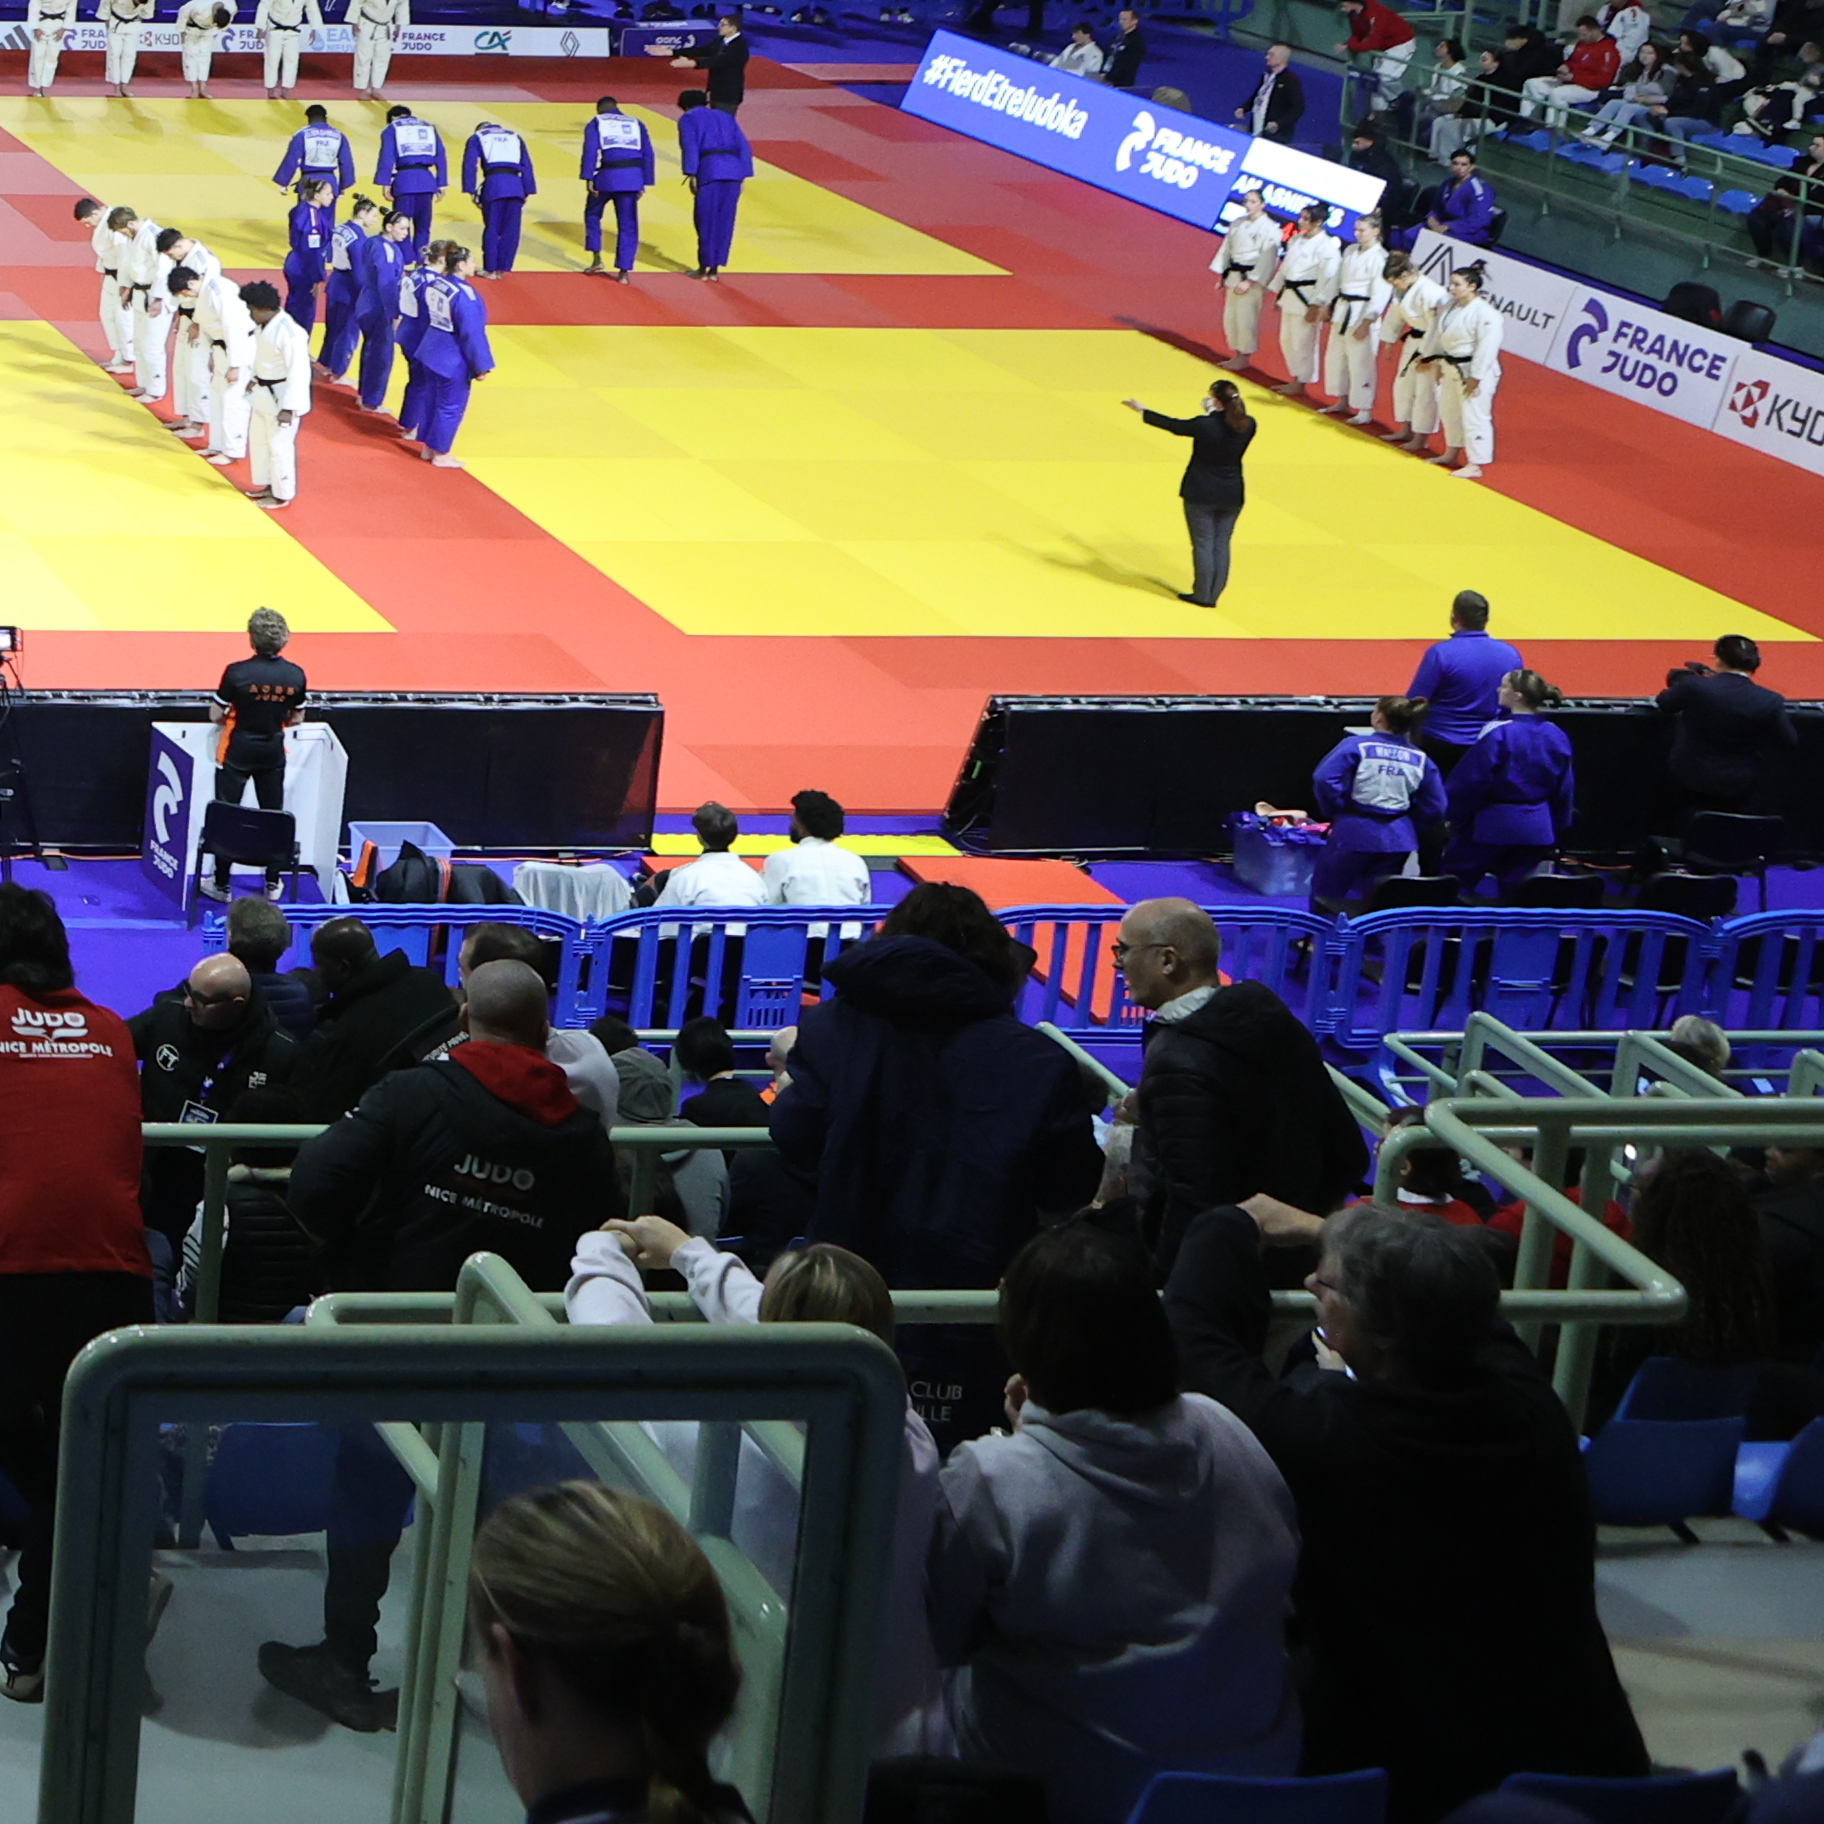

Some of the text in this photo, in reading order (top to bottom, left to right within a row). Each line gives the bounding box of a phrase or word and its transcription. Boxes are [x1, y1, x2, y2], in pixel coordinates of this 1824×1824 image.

[402, 32, 446, 43] FRANCE
[402, 42, 433, 52] JUDO
[1151, 127, 1236, 174] FRANCE
[1139, 150, 1199, 189] JUDO
[1612, 319, 1728, 381] FRANCE
[1598, 349, 1679, 397] JUDO
[149, 838, 179, 871] FRANCE
[10, 1007, 87, 1028] JUDO
[454, 1153, 535, 1191] JUDO
[424, 1183, 458, 1205] NICE
[910, 1380, 963, 1401] CLUB
